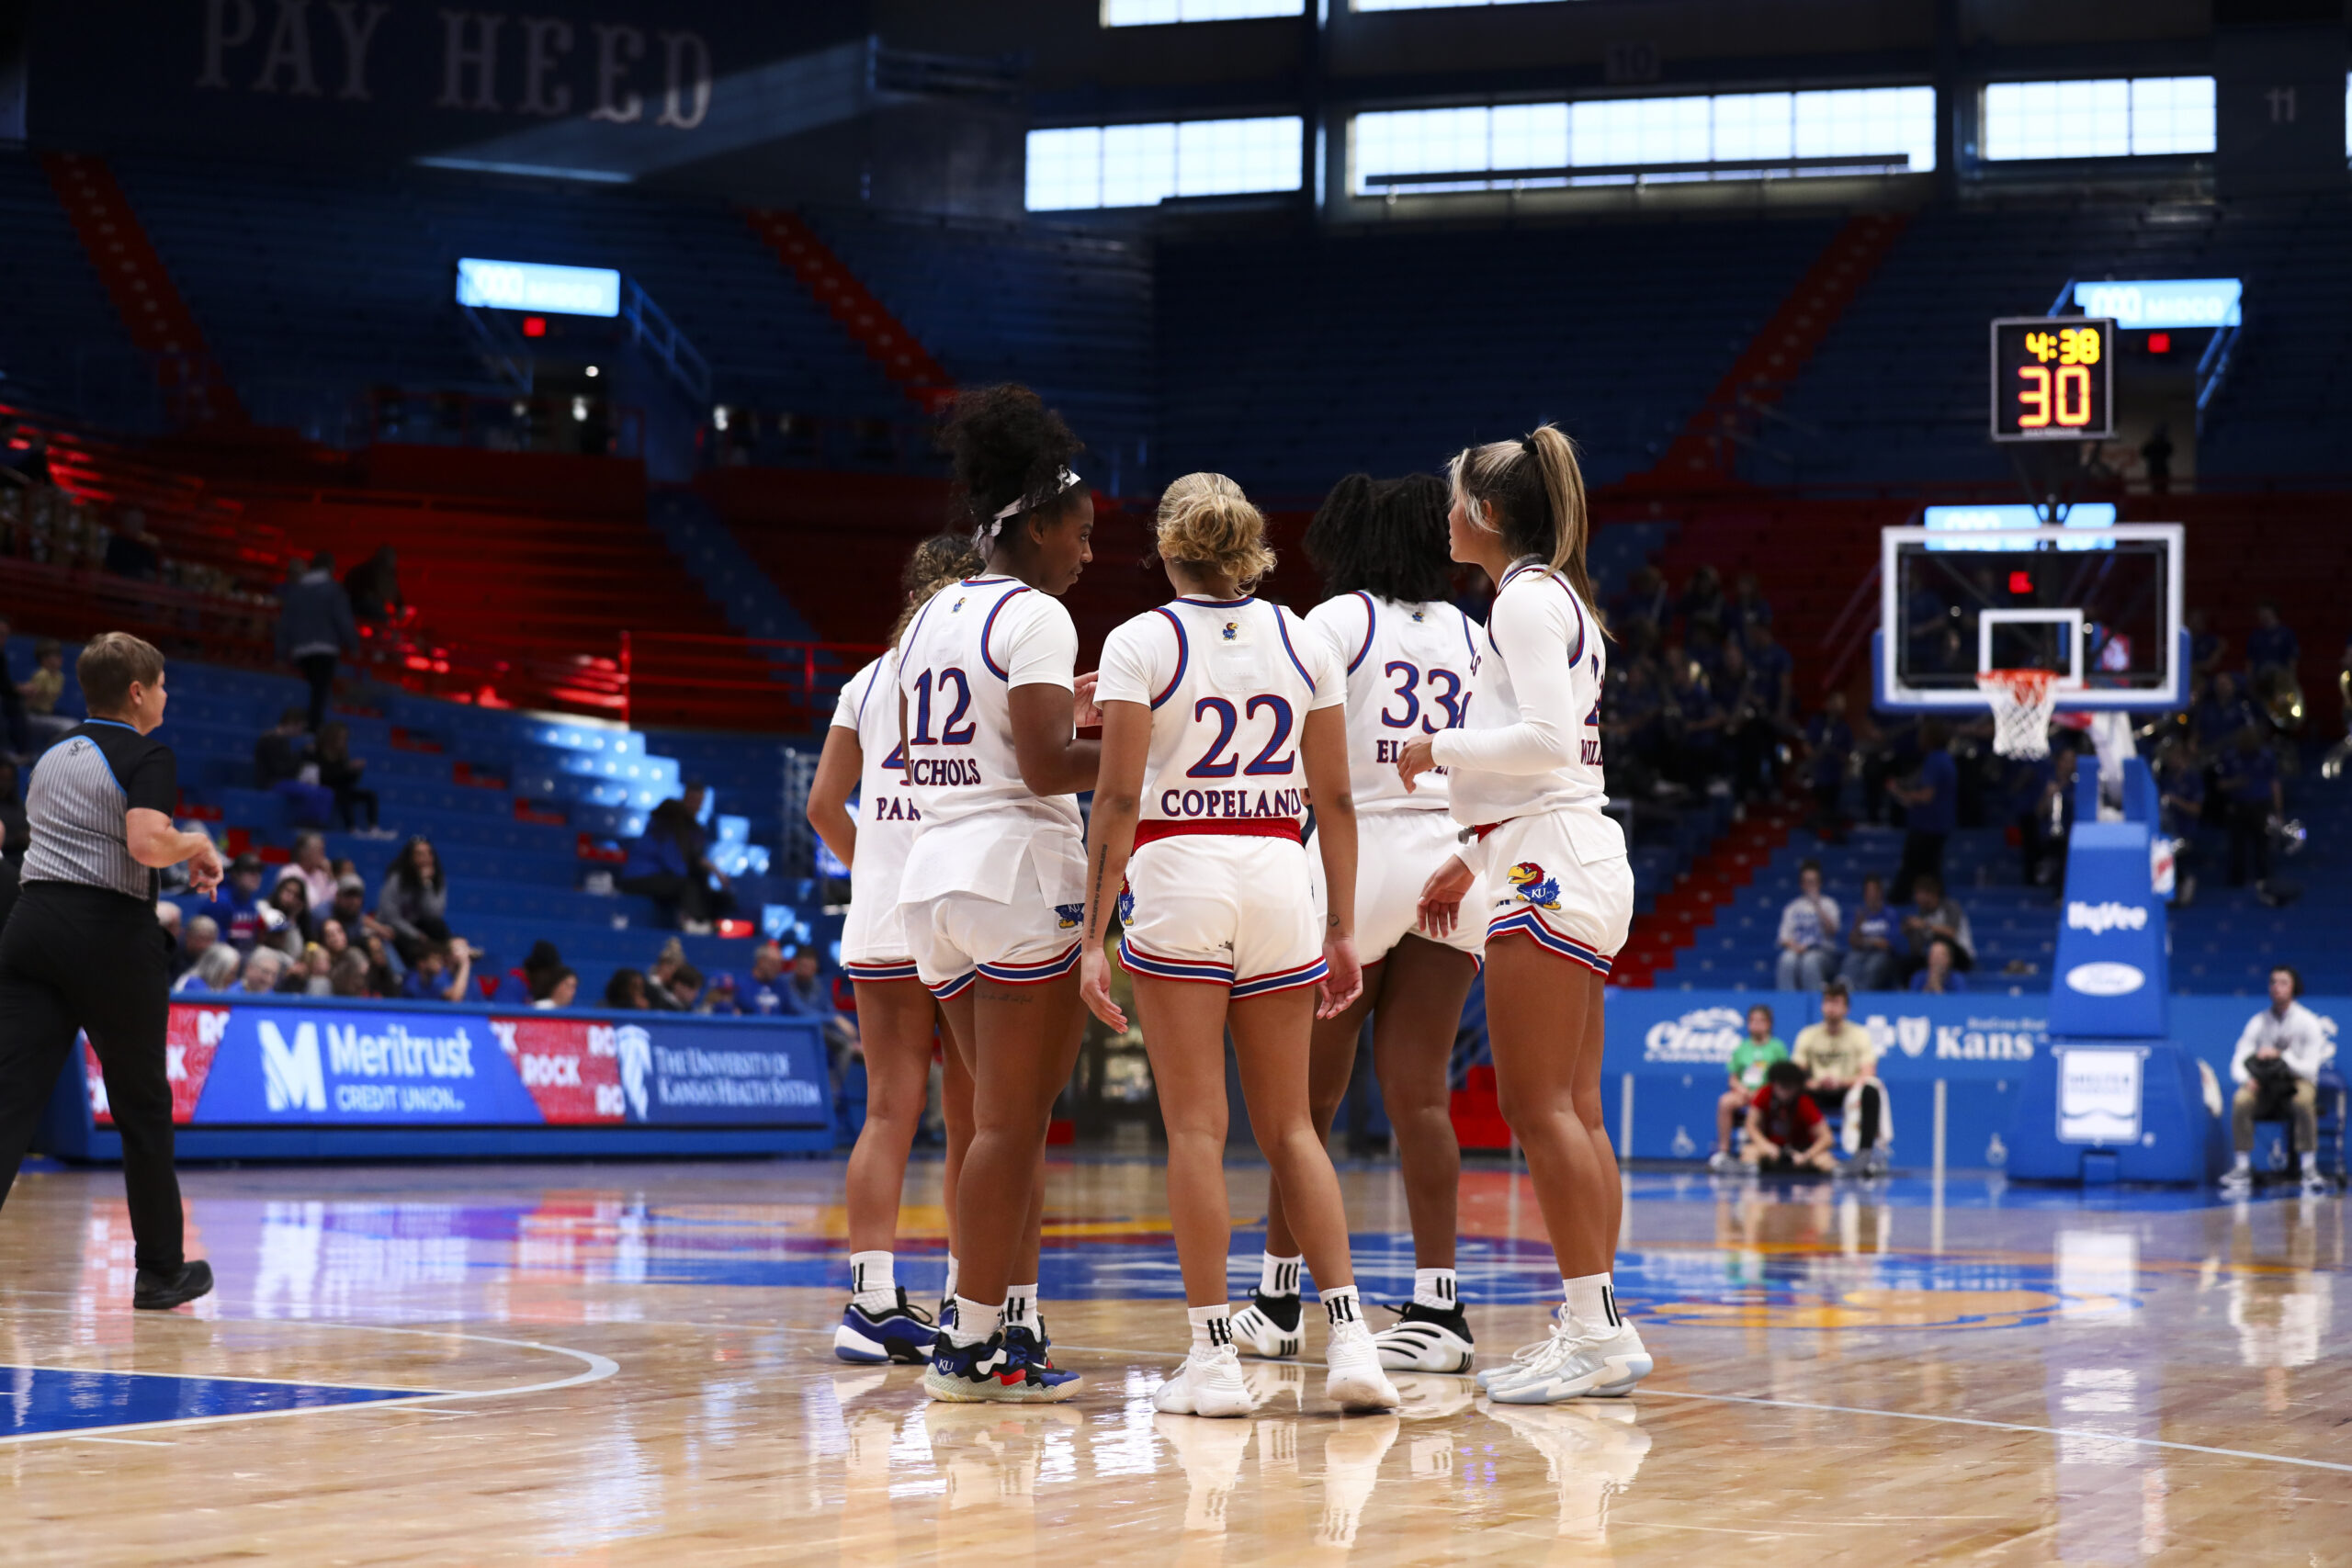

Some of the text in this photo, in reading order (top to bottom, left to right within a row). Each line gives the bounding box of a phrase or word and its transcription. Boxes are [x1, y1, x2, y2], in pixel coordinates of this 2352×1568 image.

[194, 0, 713, 130] PAY HEED
[2263, 86, 2297, 123] 11
[2025, 328, 2100, 365] 4:38
[2018, 365, 2091, 428] 30
[910, 668, 976, 745] 12
[1382, 660, 1462, 735] 33
[1186, 694, 1295, 778] 22
[1161, 788, 1301, 817] COPELAND
[1531, 887, 1547, 899] KU
[326, 1023, 475, 1077] Meritrust
[522, 1053, 582, 1088] ROCK
[335, 1085, 397, 1112] CREDIT
[938, 1359, 955, 1372] KU
